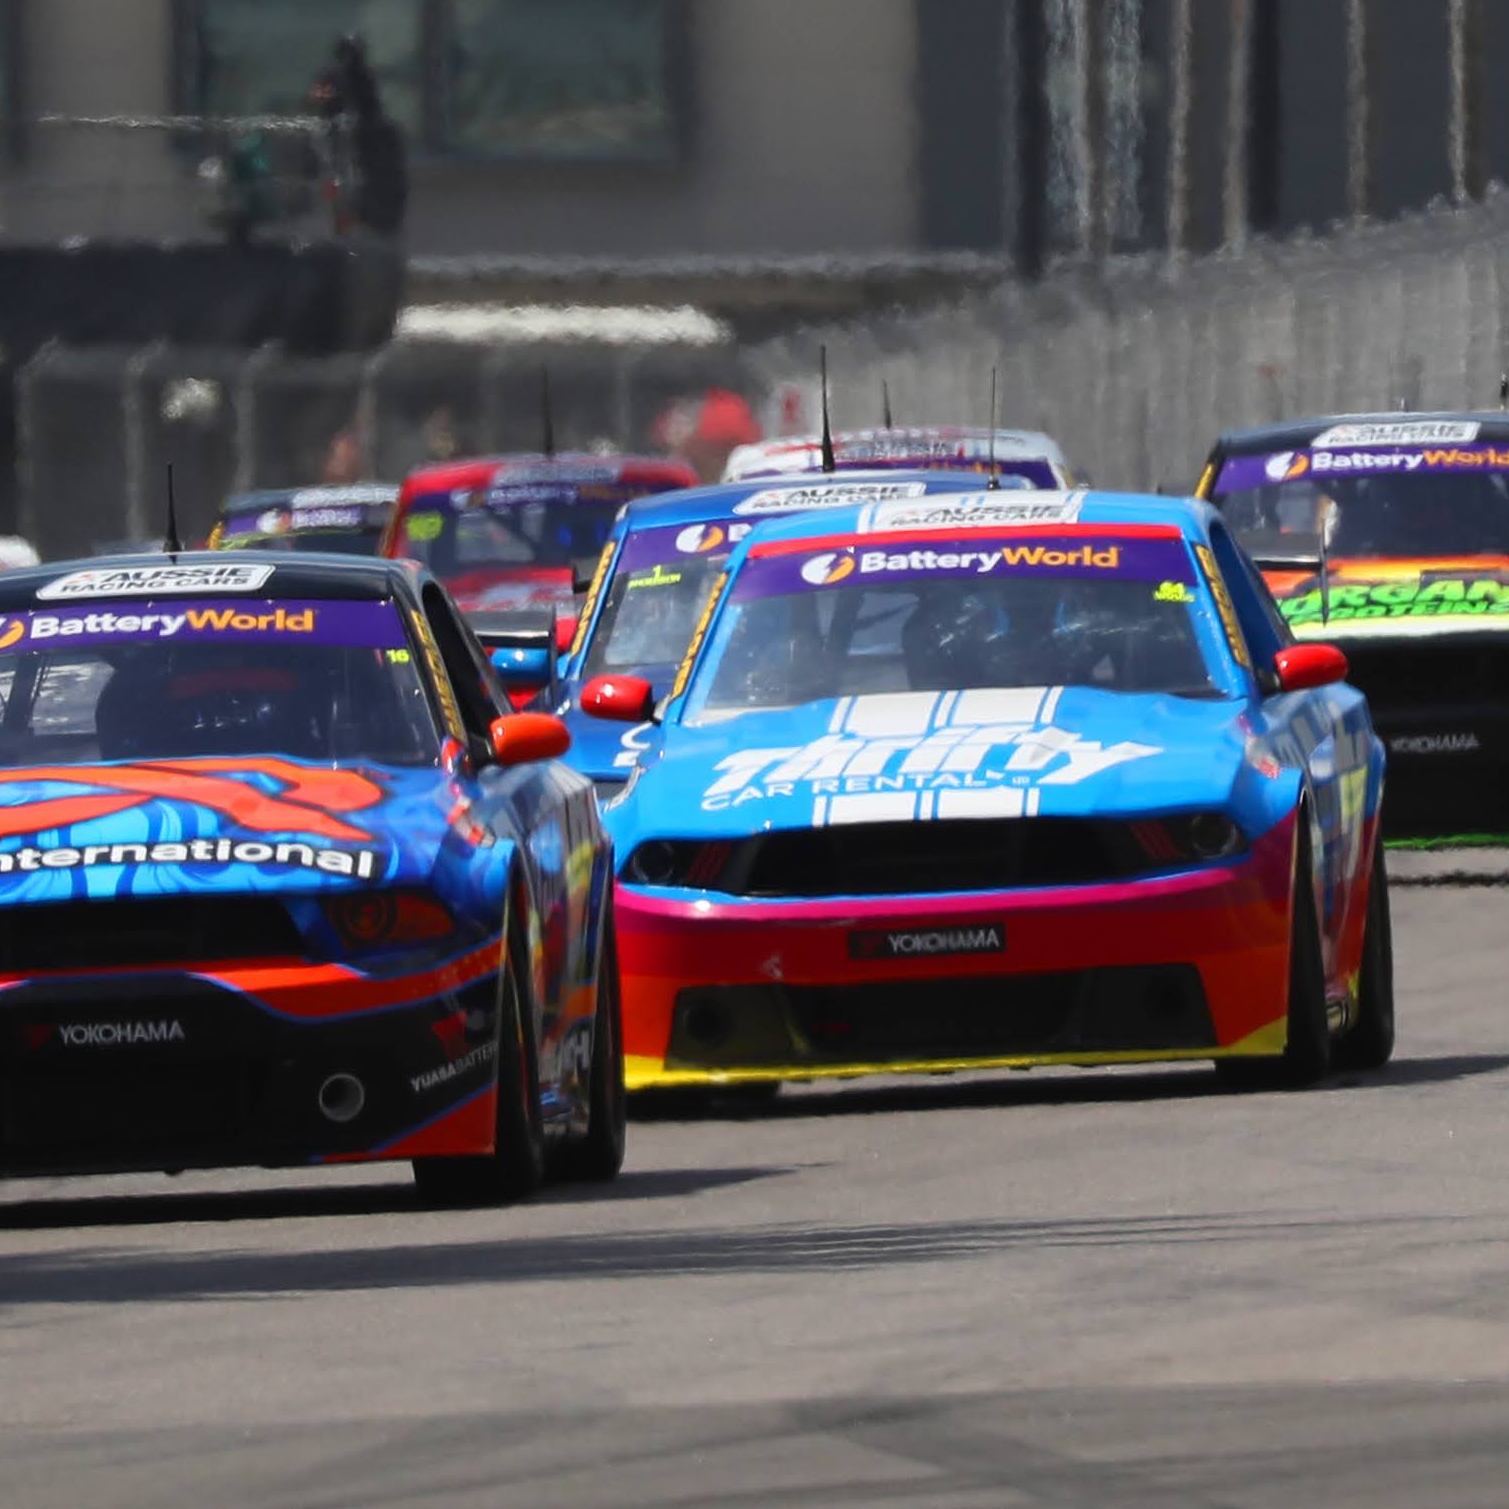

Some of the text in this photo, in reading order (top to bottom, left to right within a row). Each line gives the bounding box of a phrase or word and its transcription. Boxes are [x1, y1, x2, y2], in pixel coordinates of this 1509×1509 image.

[860, 546, 1120, 573] BatteryWorld
[60, 575, 250, 593] RACING CARS
[101, 566, 253, 583] AUSSIE
[29, 608, 316, 640] BatteryWorld
[703, 724, 1165, 797] Thrifty
[700, 781, 794, 812] CAR
[888, 927, 1001, 953] YOKOHAMA
[59, 1019, 186, 1046] YOKOHAMA
